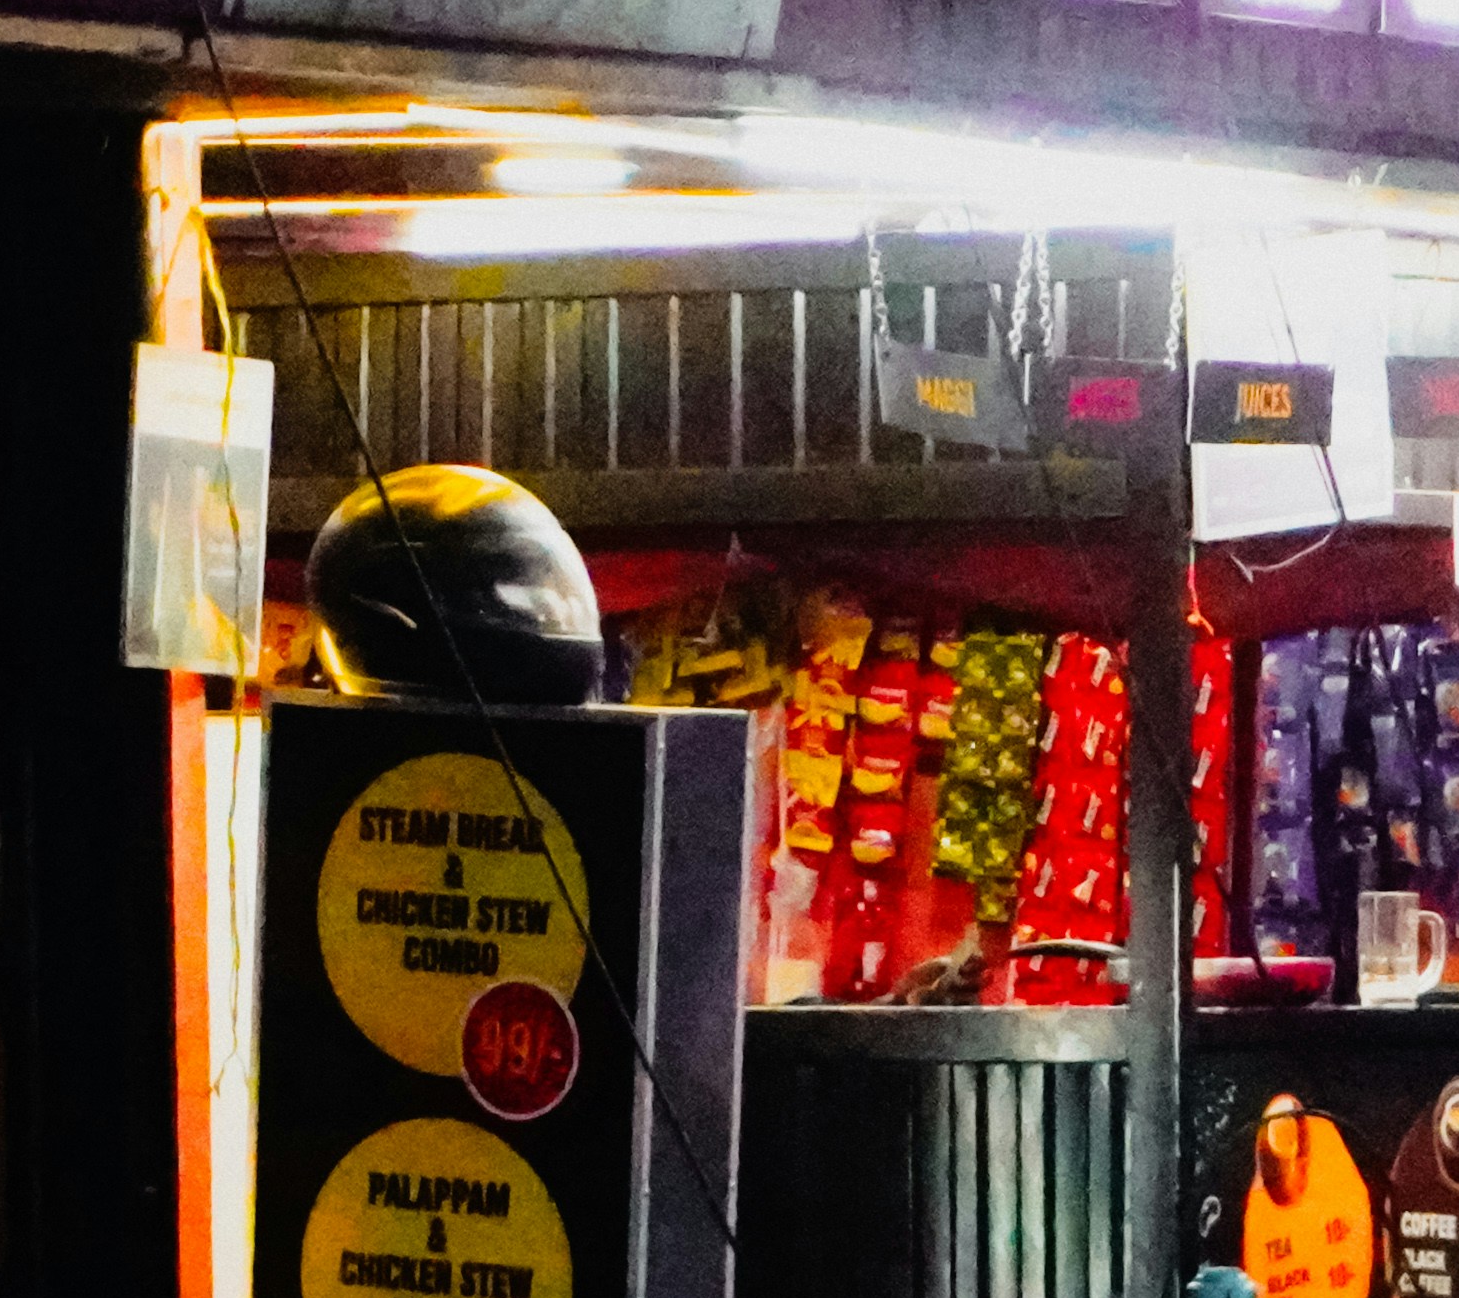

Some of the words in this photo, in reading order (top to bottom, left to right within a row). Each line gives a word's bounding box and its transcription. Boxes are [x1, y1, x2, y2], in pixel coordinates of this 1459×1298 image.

[356, 887, 471, 931] CHICKEN
[476, 894, 551, 936] STEW
[401, 934, 501, 977] COMBO
[367, 1171, 512, 1218] PALAPPAM
[1399, 1209, 1459, 1241] COFFEE
[339, 1249, 453, 1295] CHICKEN
[1403, 1247, 1447, 1273] LACK
